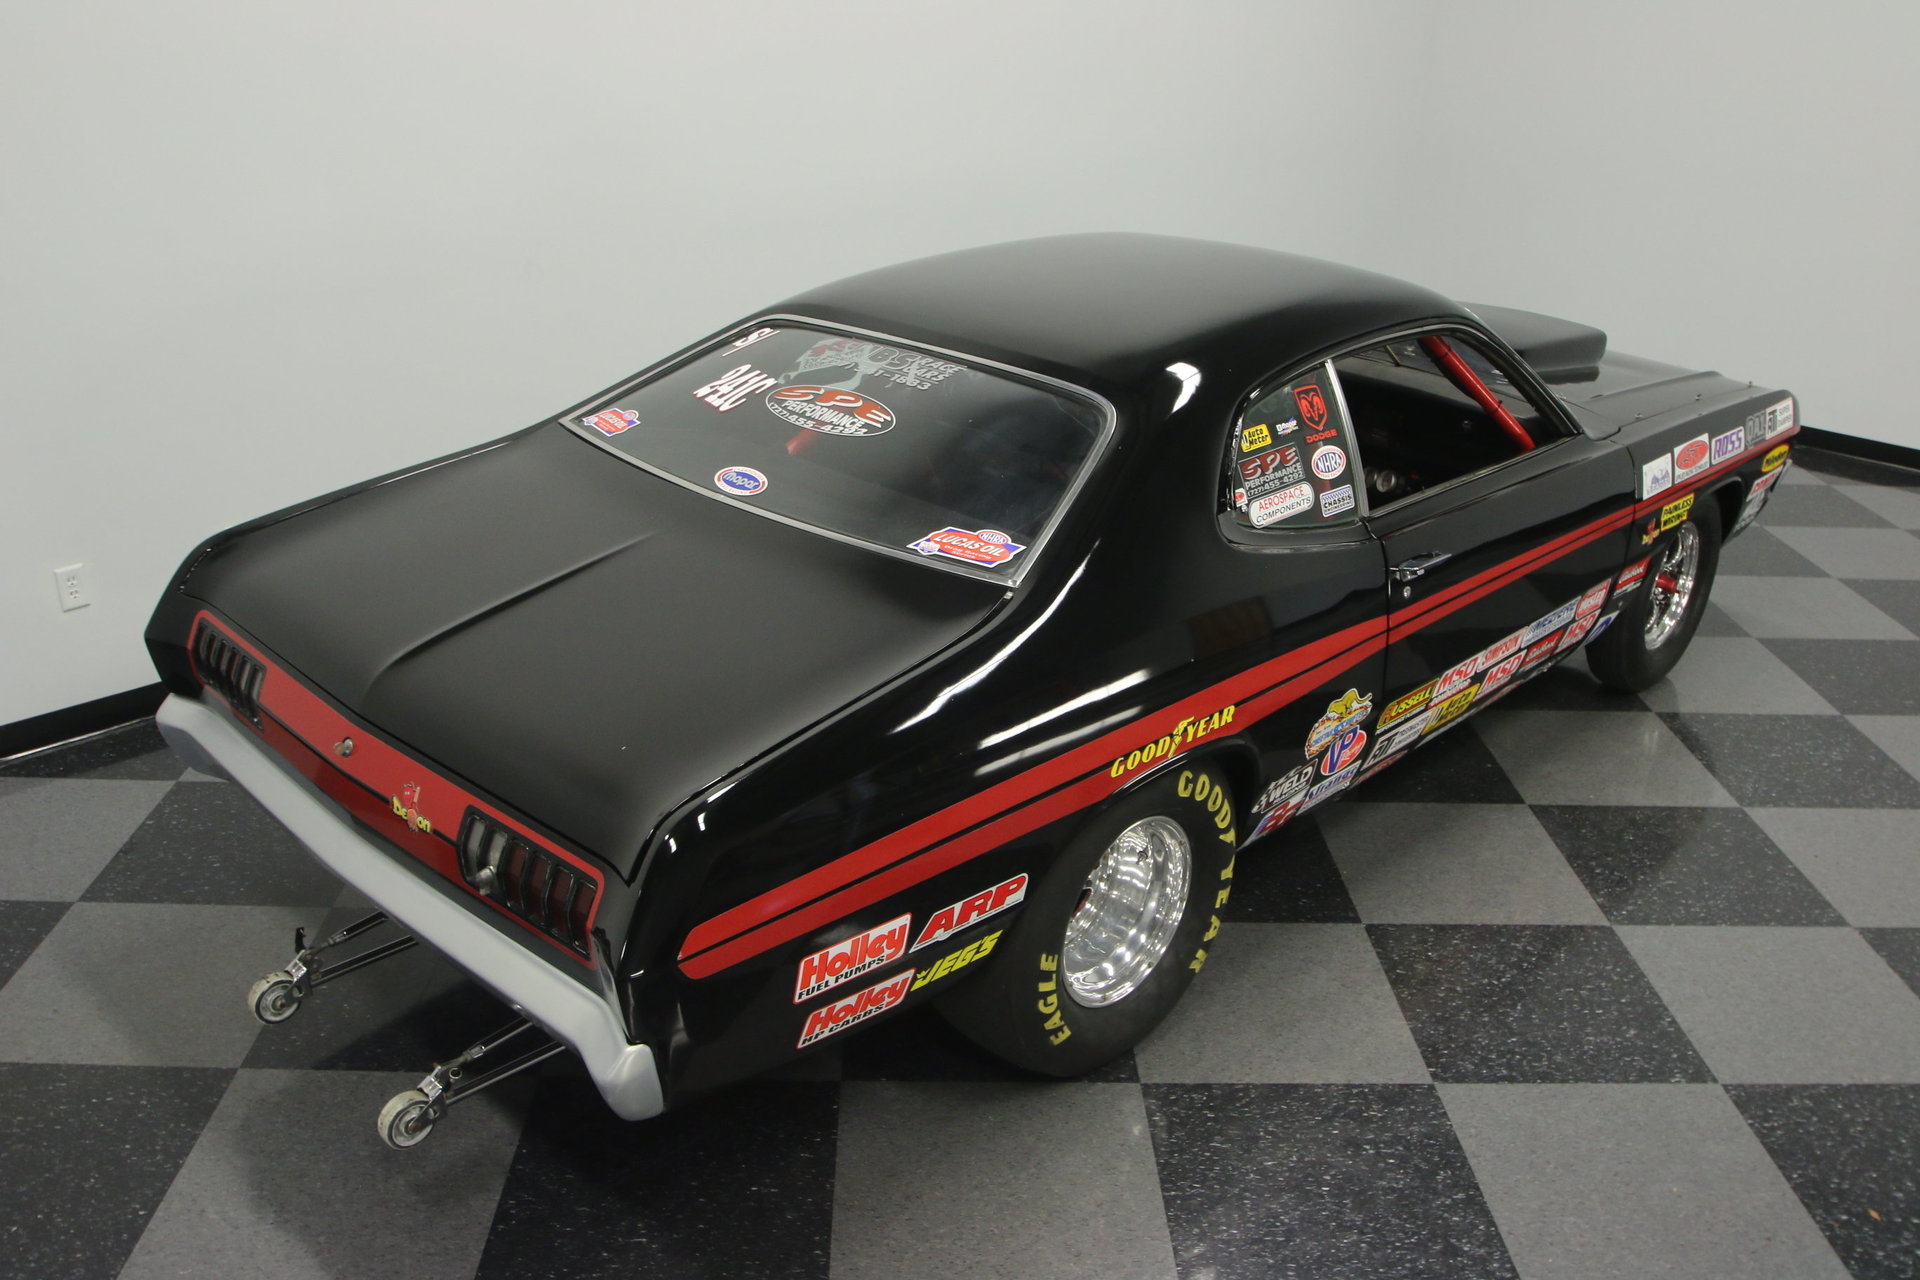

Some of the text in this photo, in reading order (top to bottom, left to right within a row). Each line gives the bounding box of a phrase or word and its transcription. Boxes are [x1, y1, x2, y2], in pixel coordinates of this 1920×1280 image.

[773, 385, 892, 428] SPE
[781, 400, 866, 431] PERFORMANCE
[1305, 428, 1338, 444] DODGE
[1713, 428, 1743, 461] ROSS
[1240, 447, 1298, 480] SPE
[1244, 462, 1303, 490] PERFORMANCE
[1317, 452, 1342, 473] NHRA
[1256, 496, 1311, 523] COMPONENTS
[1258, 486, 1305, 511] AEROSPACE
[1324, 494, 1352, 509] CHASSIS
[1663, 495, 1694, 513] PAINLESS
[933, 533, 1005, 557] LUCAS OIL
[980, 532, 1007, 545] NHRA
[1481, 634, 1521, 666] SIMPSON
[1437, 656, 1480, 694] MSD
[1481, 653, 1523, 691] MSD
[1382, 686, 1434, 722] RUSSELL
[1327, 725, 1360, 774] VP
[1268, 765, 1314, 803] WELD
[915, 875, 1027, 944] ARP
[799, 923, 908, 989] Holley
[797, 955, 886, 1000] FUEL PUMPS
[803, 976, 911, 1038] Holley
[1038, 953, 1073, 1046] EAGLE
[801, 1003, 885, 1047] HP CARBS
